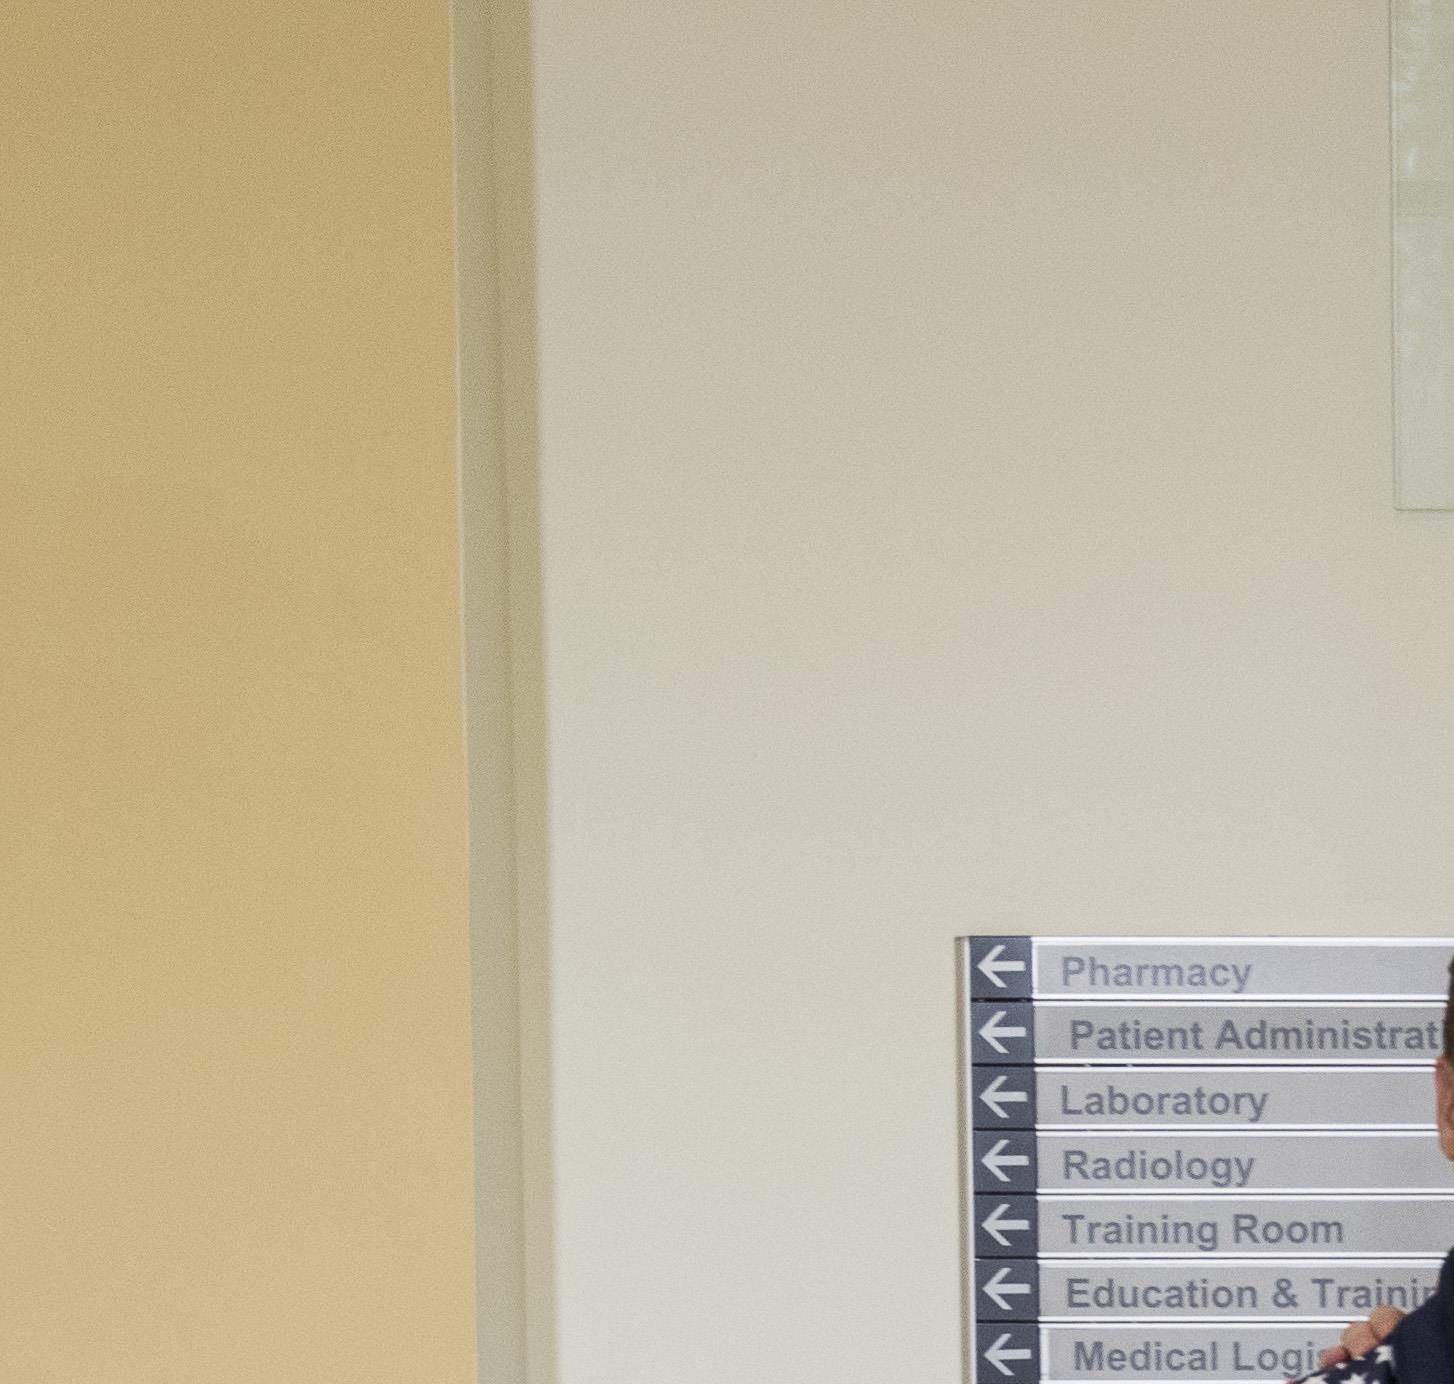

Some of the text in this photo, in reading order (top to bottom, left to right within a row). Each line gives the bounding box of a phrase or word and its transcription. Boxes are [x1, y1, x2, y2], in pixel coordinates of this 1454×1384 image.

[1062, 955, 1252, 994] Pharmacy
[1070, 1019, 1204, 1051] Patient
[1061, 1085, 1268, 1124] Laboratory
[1063, 1149, 1255, 1186] Radiology
[1061, 1213, 1343, 1251] Training Room
[1066, 1277, 1258, 1309] Education
[1272, 1277, 1299, 1309] &
[1074, 1340, 1218, 1372] Medical
